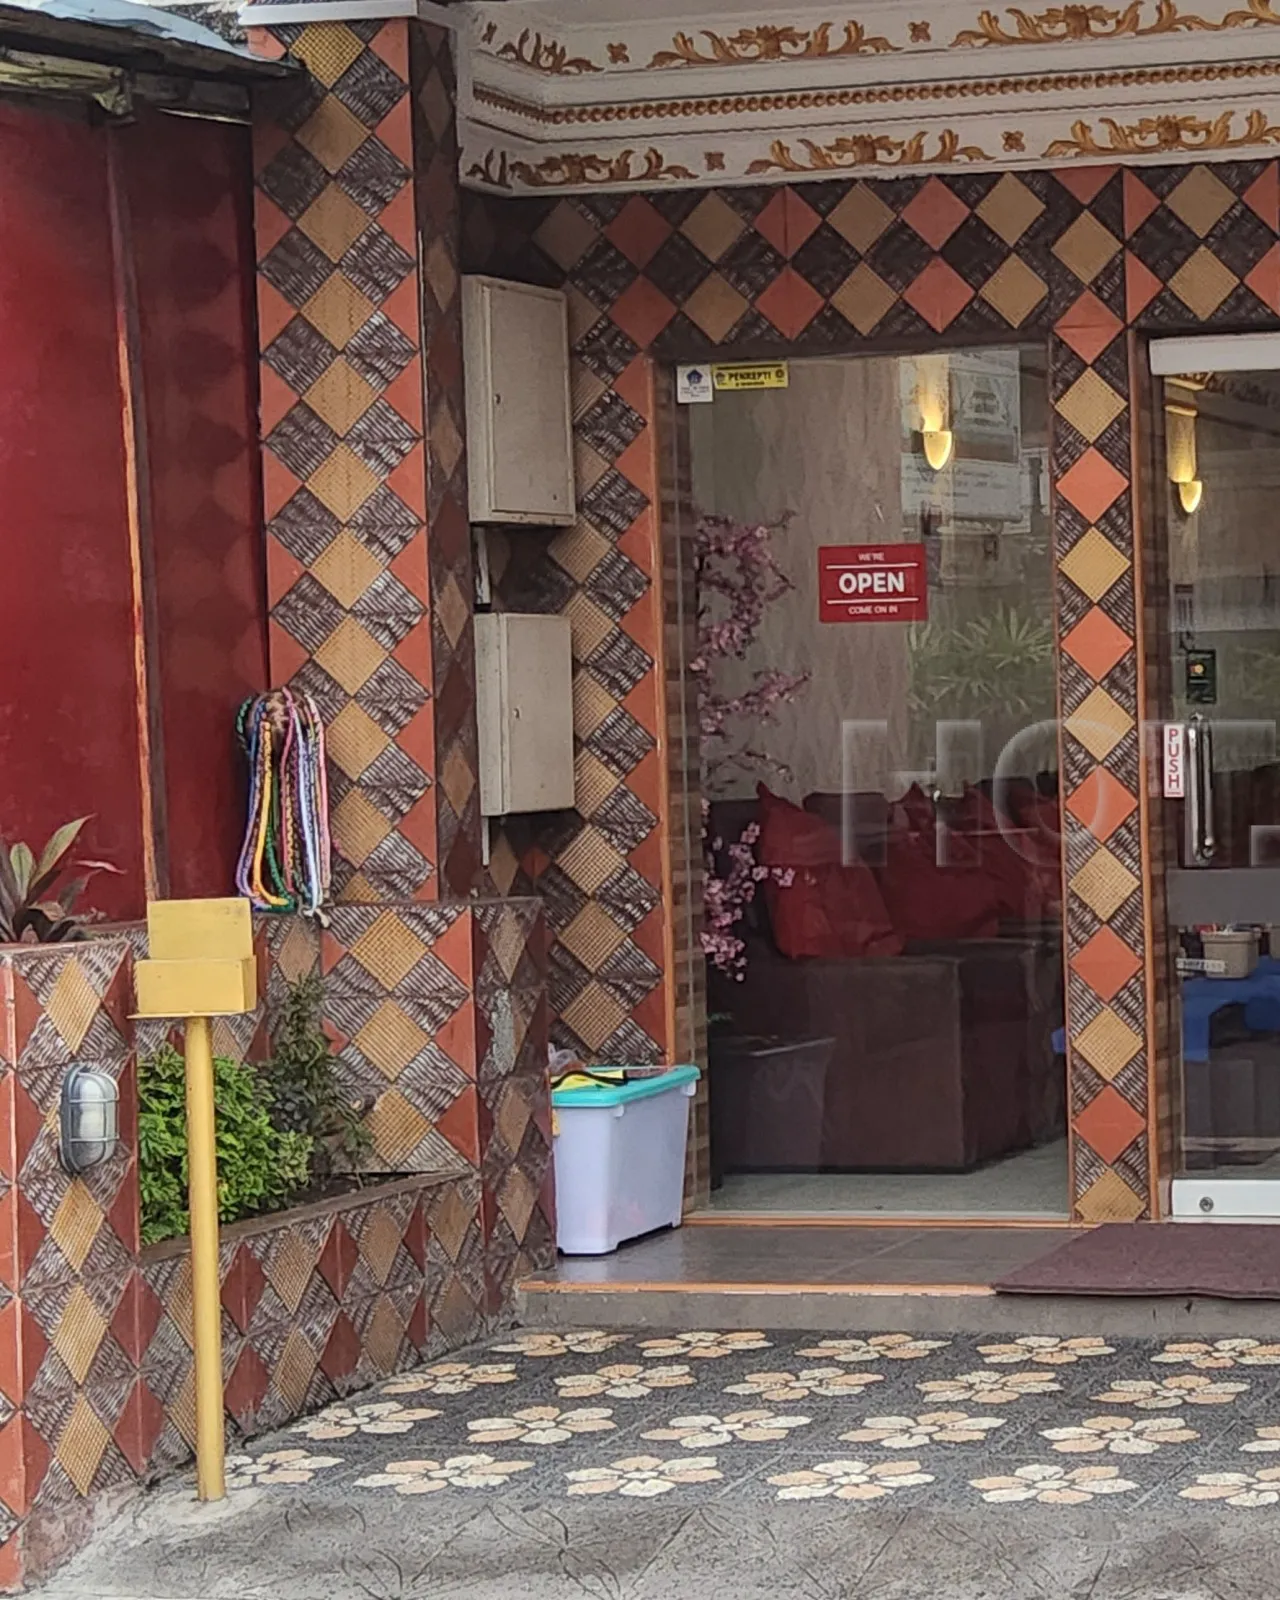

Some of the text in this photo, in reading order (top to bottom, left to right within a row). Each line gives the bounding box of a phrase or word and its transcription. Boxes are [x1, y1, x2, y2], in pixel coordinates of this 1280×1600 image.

[839, 571, 905, 594] OPEN
[848, 604, 898, 615] COME ON IN
[1168, 728, 1180, 788] PUSH
